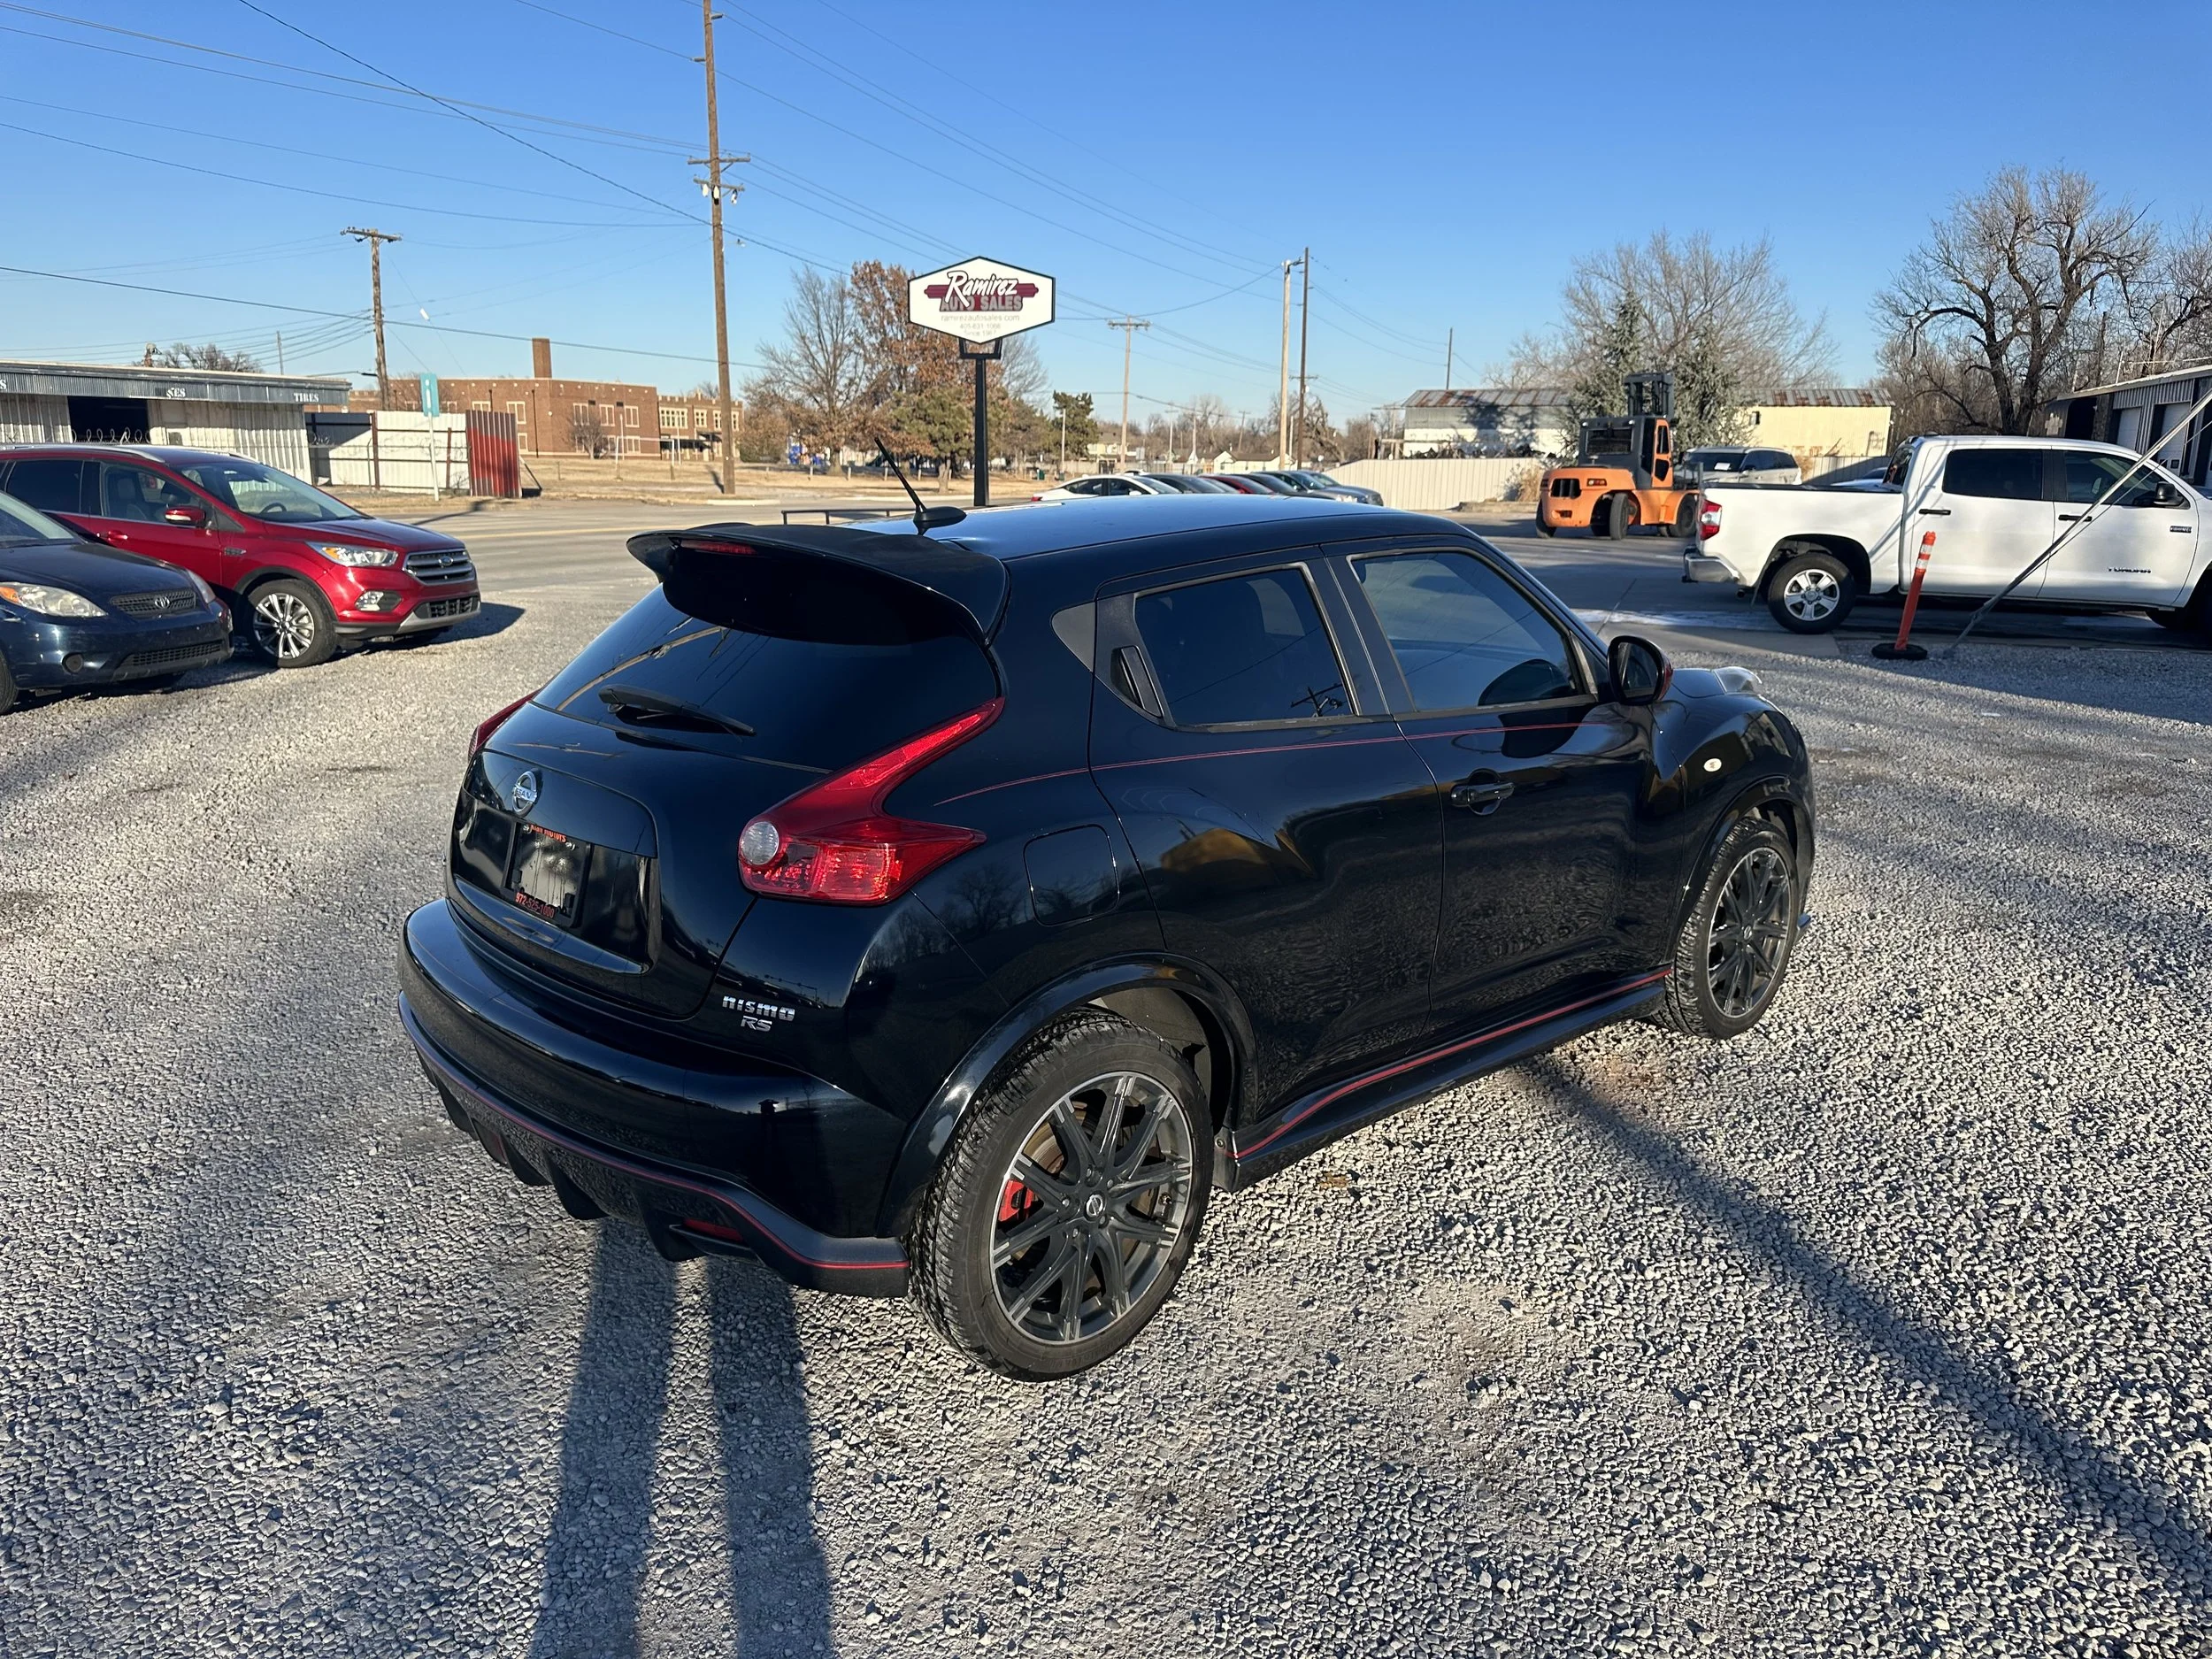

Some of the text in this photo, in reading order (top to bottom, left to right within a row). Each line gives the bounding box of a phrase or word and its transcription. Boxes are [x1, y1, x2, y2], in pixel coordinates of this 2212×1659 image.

[946, 270, 1018, 307] Ramirez
[940, 295, 1022, 311] AUTO SALES
[294, 392, 319, 403] TIRES
[740, 1015, 773, 1033] RS
